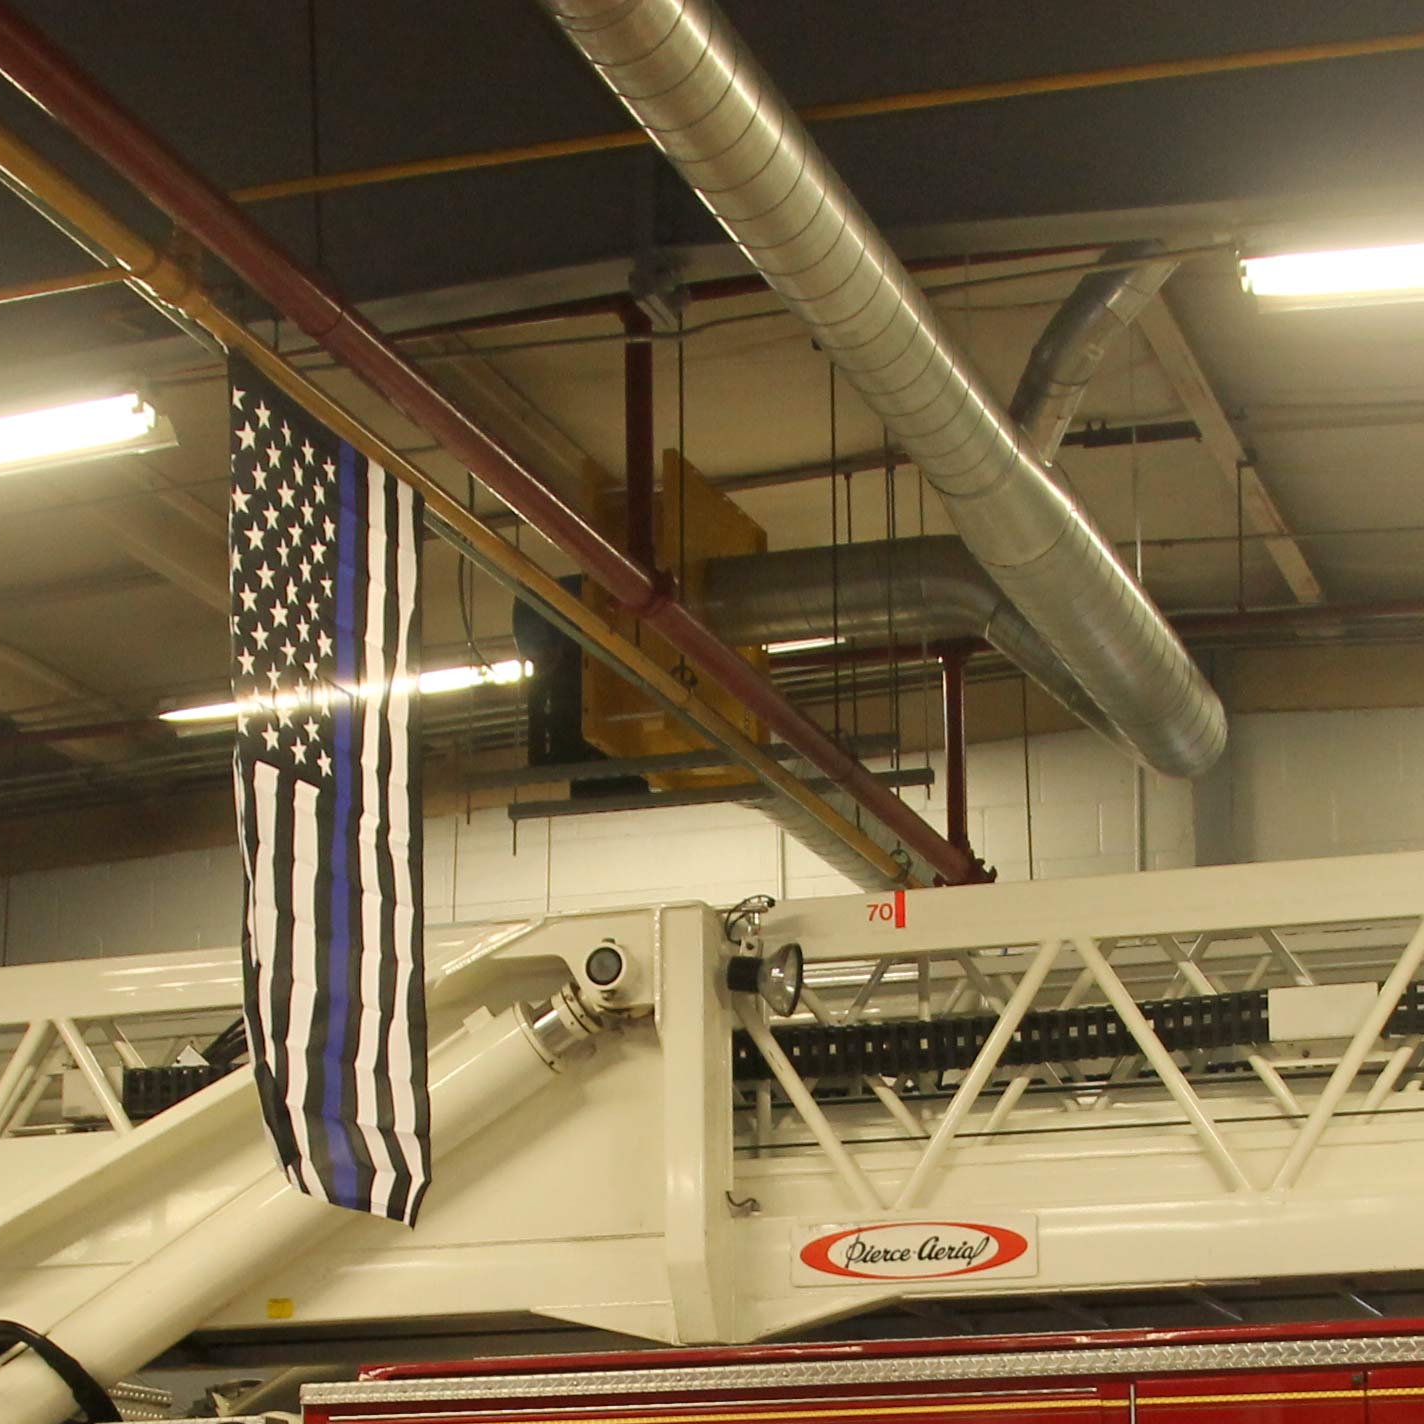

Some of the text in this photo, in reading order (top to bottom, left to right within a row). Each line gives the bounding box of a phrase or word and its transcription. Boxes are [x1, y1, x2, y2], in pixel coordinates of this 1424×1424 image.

[866, 903, 893, 921] 70
[844, 1234, 990, 1269] Pierce Aerial
